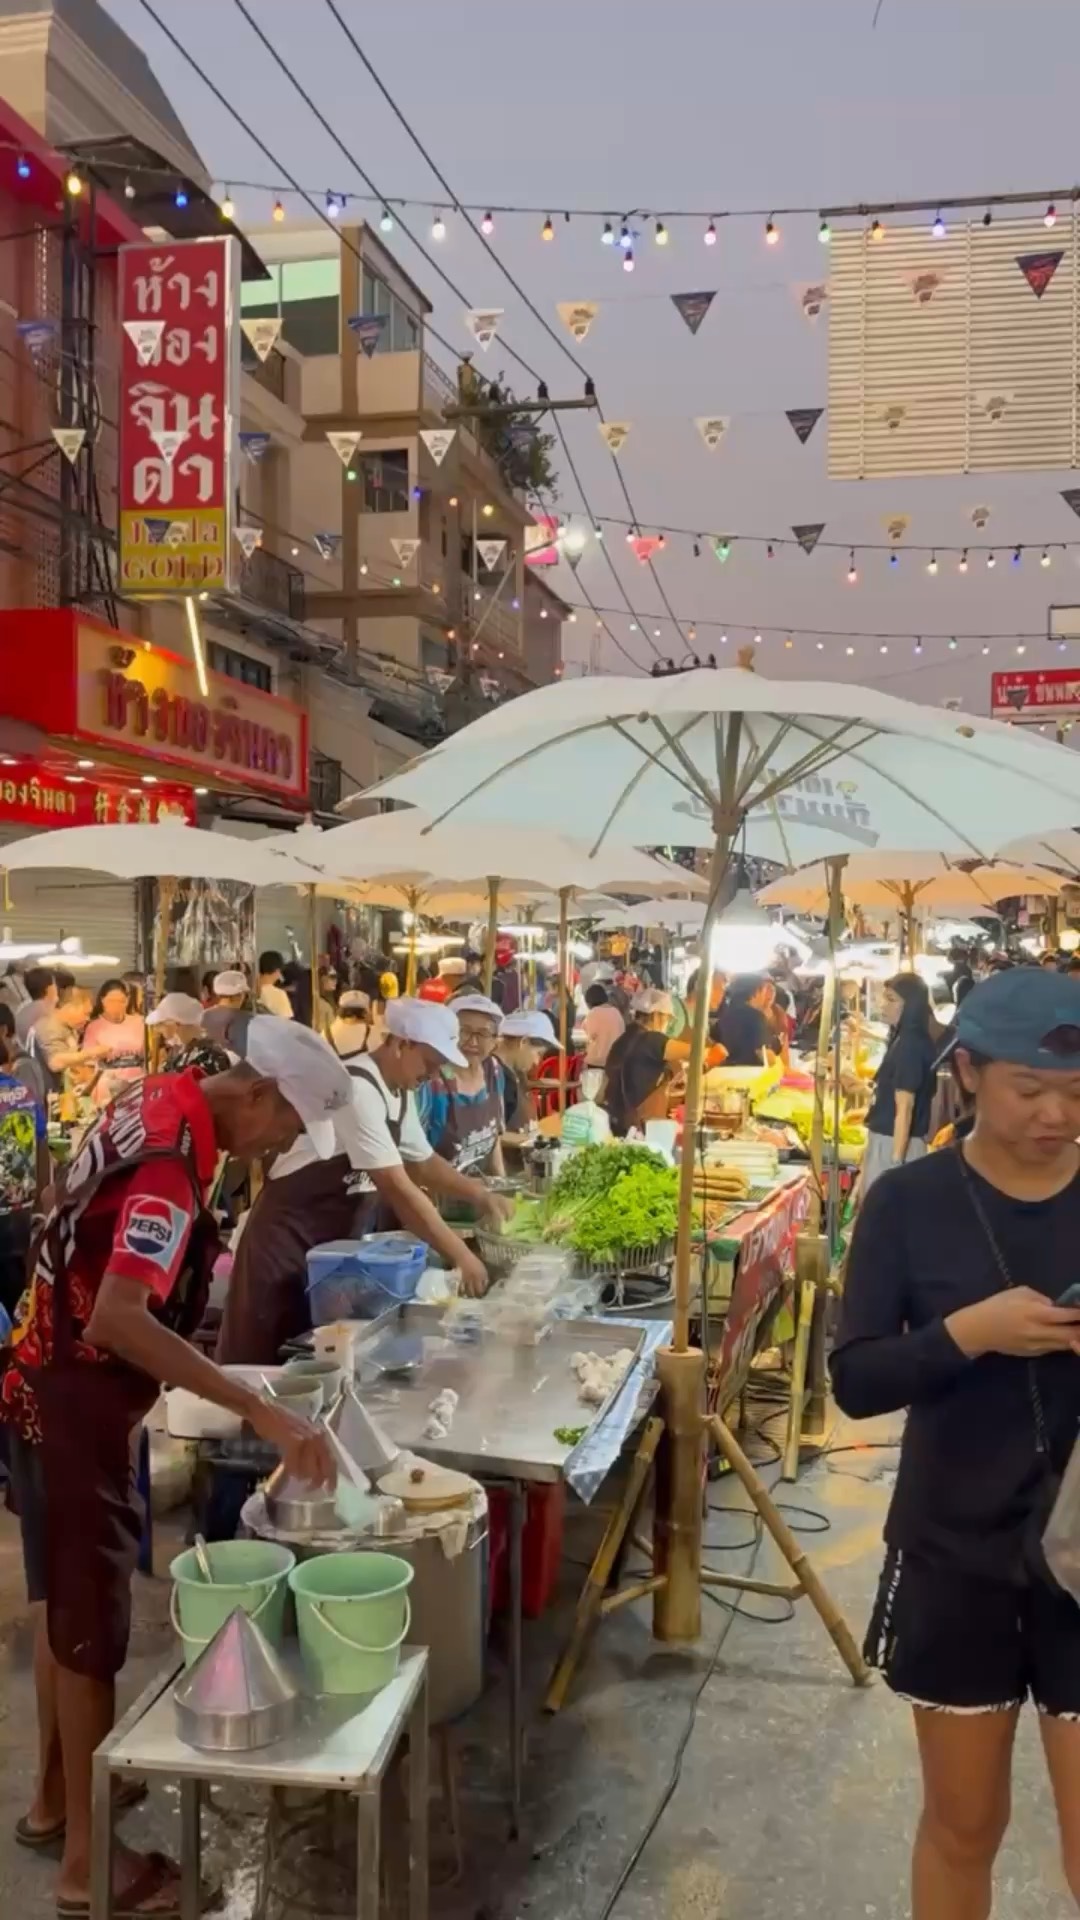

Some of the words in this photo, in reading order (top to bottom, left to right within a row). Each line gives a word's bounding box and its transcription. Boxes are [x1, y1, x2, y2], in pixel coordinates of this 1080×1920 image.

[132, 255, 218, 314] ห้าง
[128, 381, 220, 442] จิน
[133, 453, 214, 505] ดา
[131, 1216, 174, 1243] PEPSI
